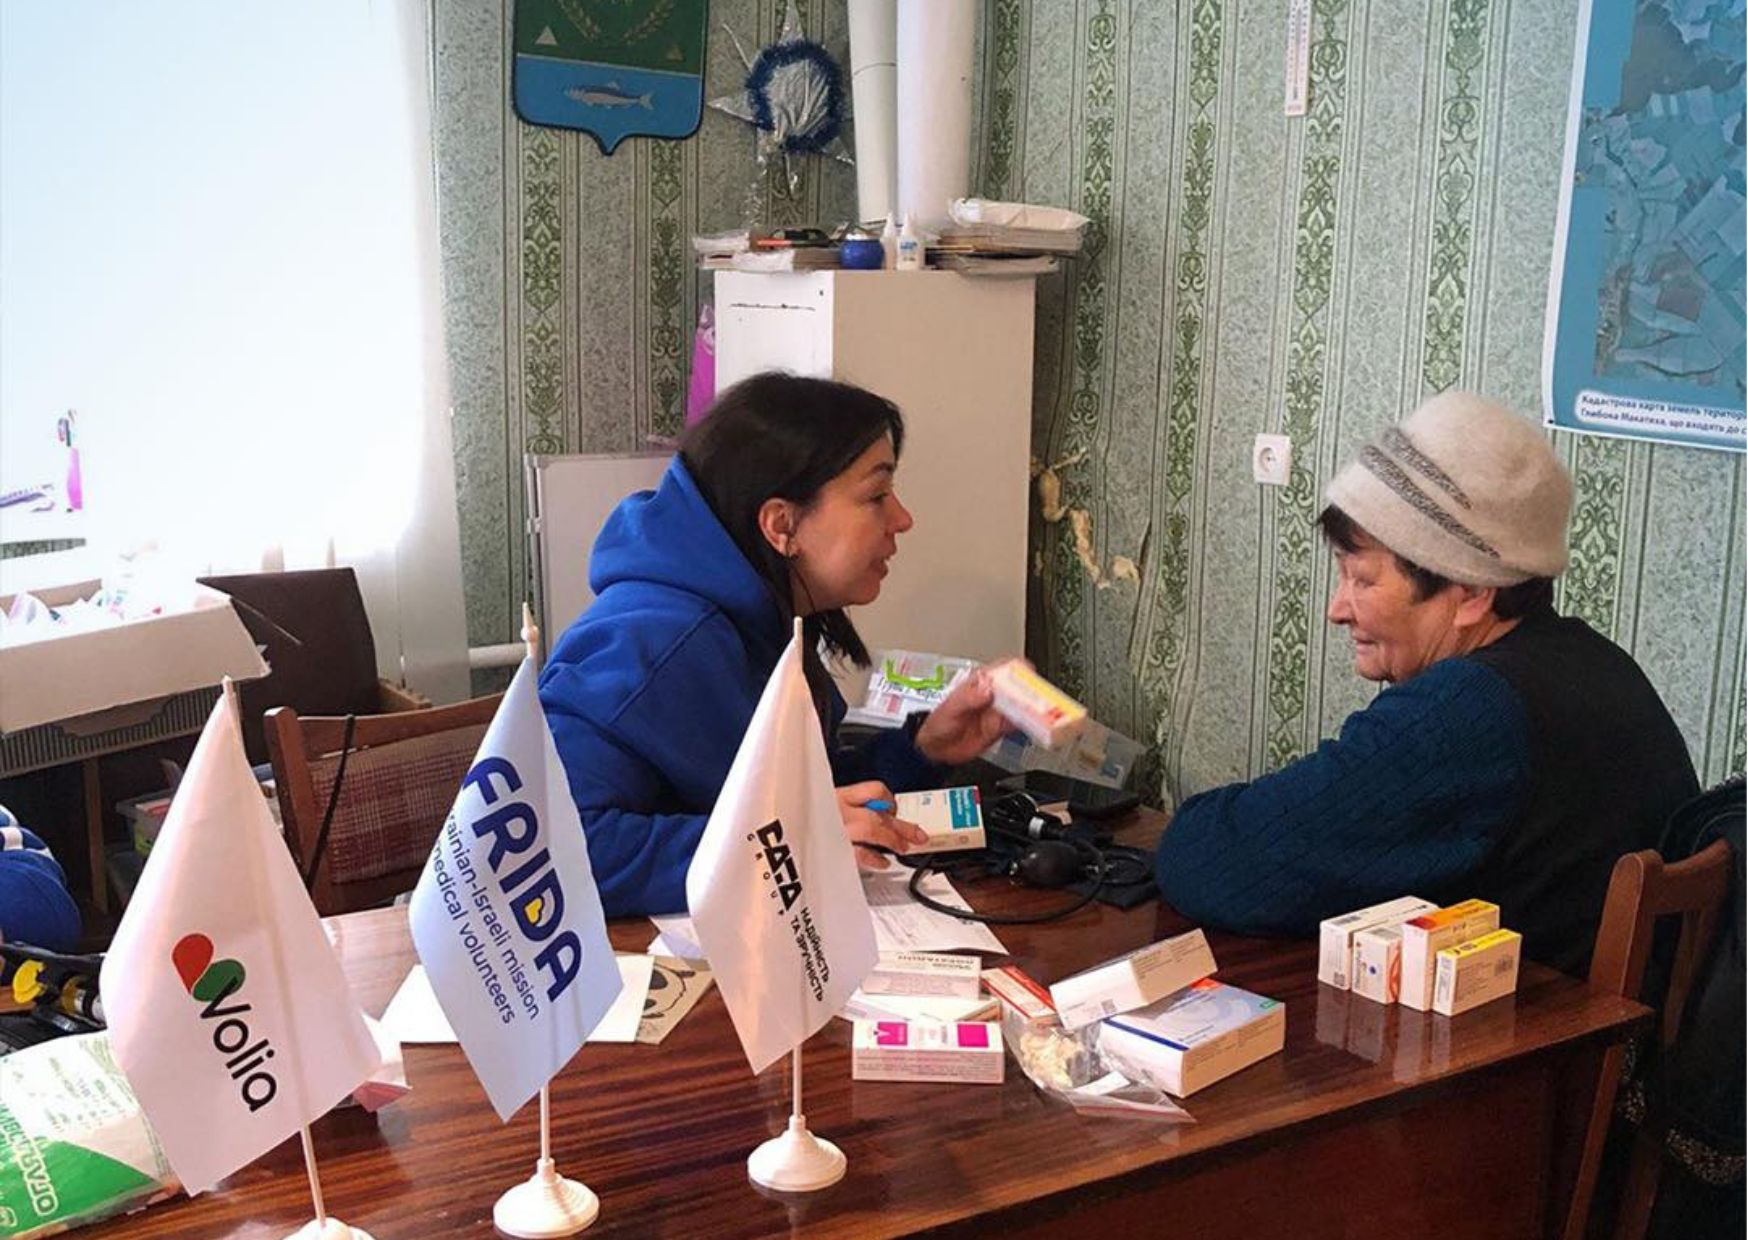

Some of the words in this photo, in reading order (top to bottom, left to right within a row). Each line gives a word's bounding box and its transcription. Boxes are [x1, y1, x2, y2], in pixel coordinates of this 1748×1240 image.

[1582, 395, 1636, 409] Кадастрова
[1639, 401, 1665, 412] карта
[1667, 404, 1701, 415] земель
[462, 757, 582, 1003] FRIDA
[747, 833, 785, 916] GROUP
[459, 922, 515, 1024] volunteers
[502, 948, 540, 1020] mission
[791, 915, 801, 934] ТА
[796, 934, 823, 1001] ЗРУЧНІСТЬ
[800, 907, 829, 983] НАДІЙНІСТЬ
[200, 976, 277, 1113] Volia
